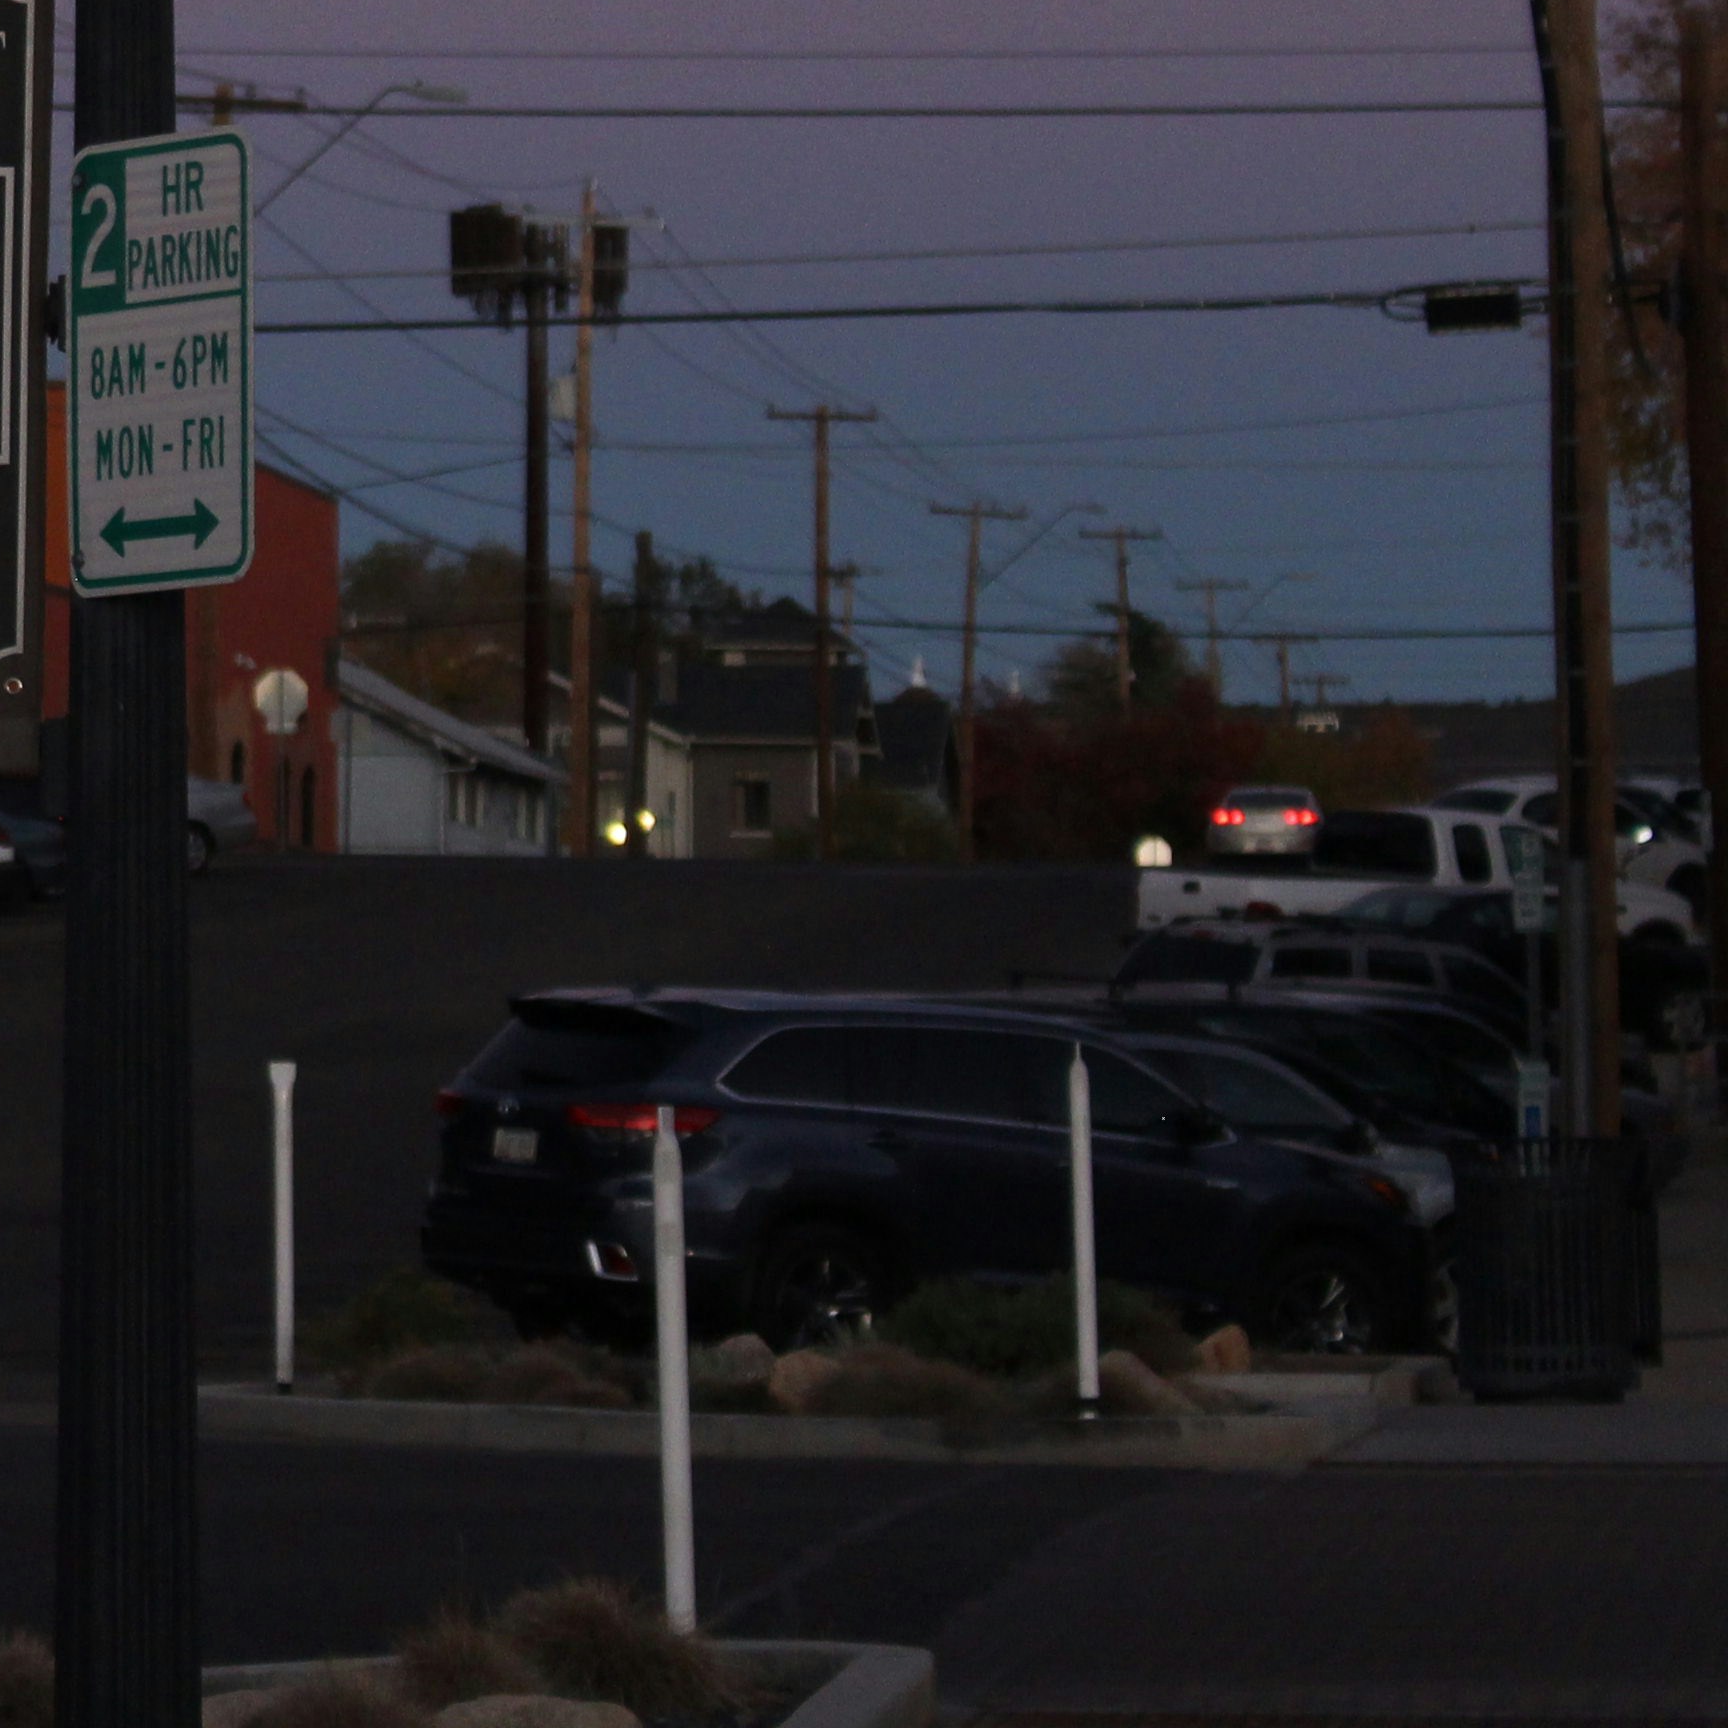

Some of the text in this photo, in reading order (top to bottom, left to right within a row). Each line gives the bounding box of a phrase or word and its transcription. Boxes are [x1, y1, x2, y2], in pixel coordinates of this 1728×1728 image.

[161, 160, 204, 217] HR
[80, 182, 118, 290] 2
[127, 224, 239, 291] PARKING
